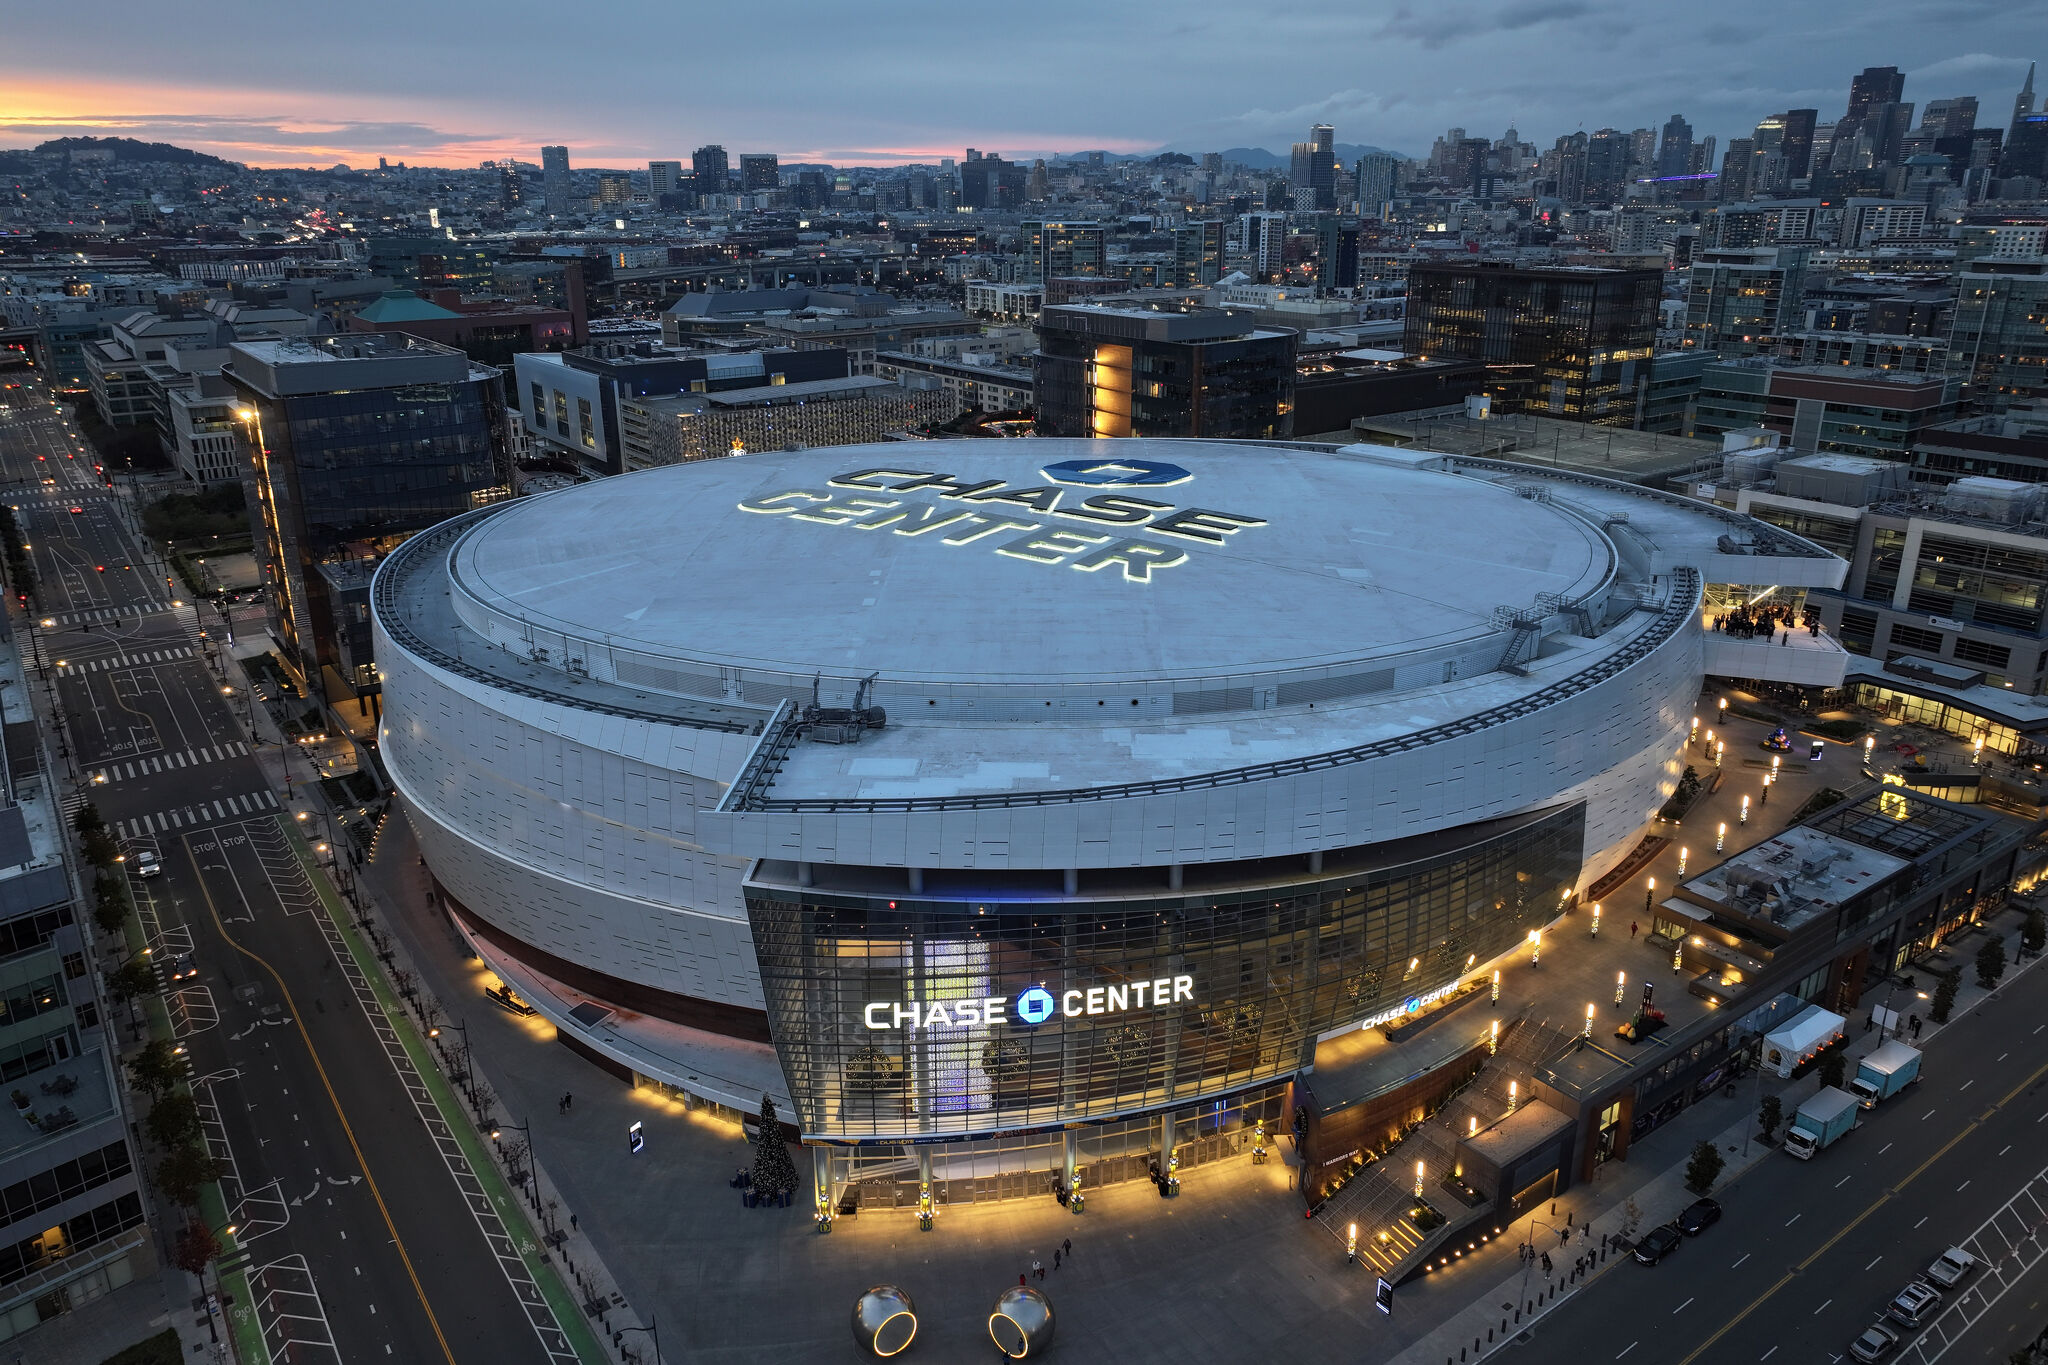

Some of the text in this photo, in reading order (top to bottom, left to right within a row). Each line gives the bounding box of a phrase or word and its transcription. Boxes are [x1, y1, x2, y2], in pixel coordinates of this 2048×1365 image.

[826, 467, 1269, 546] CHASE
[737, 488, 1190, 584] CENTER
[112, 741, 133, 752] STOP
[138, 736, 158, 746] STOP
[192, 841, 217, 854] STOP
[222, 835, 246, 848] STOP
[864, 974, 1195, 1030] CHASE CENTER
[1361, 979, 1461, 1031] CHASE CENTER
[1325, 1153, 1349, 1166] WARRIORS
[1348, 1149, 1359, 1157] WAY
